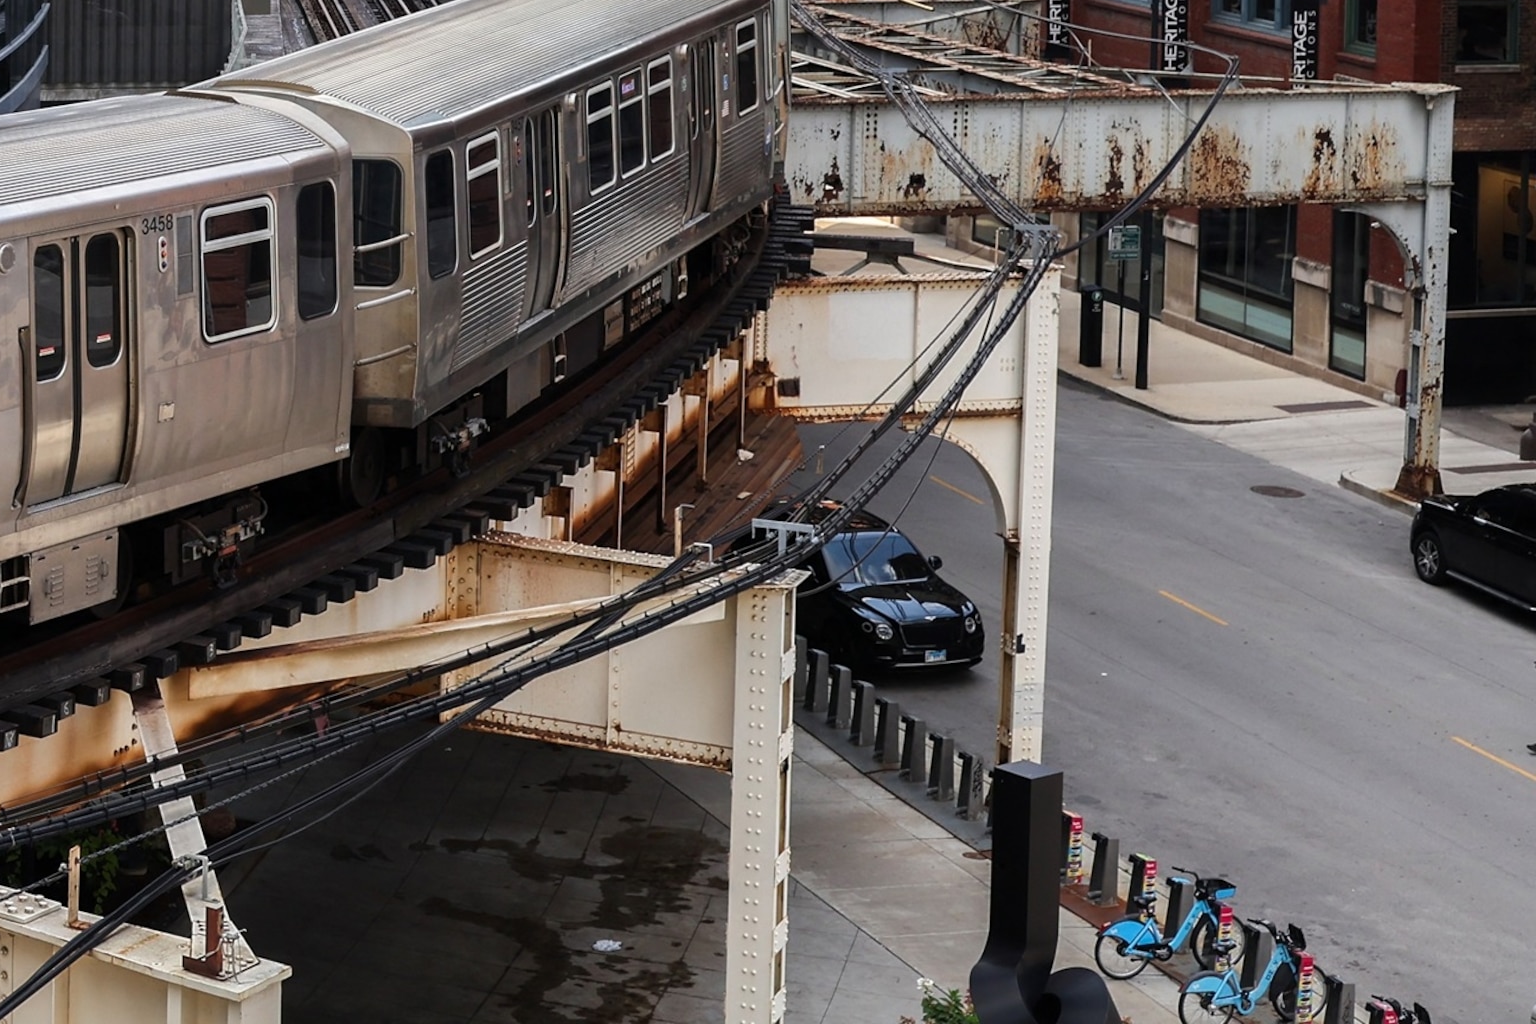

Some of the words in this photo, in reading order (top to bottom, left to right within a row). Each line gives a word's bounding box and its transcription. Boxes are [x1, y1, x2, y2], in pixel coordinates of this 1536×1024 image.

[1293, 10, 1308, 90] ERITAGE
[1306, 10, 1317, 79] CTIONS
[142, 213, 174, 235] 3458
